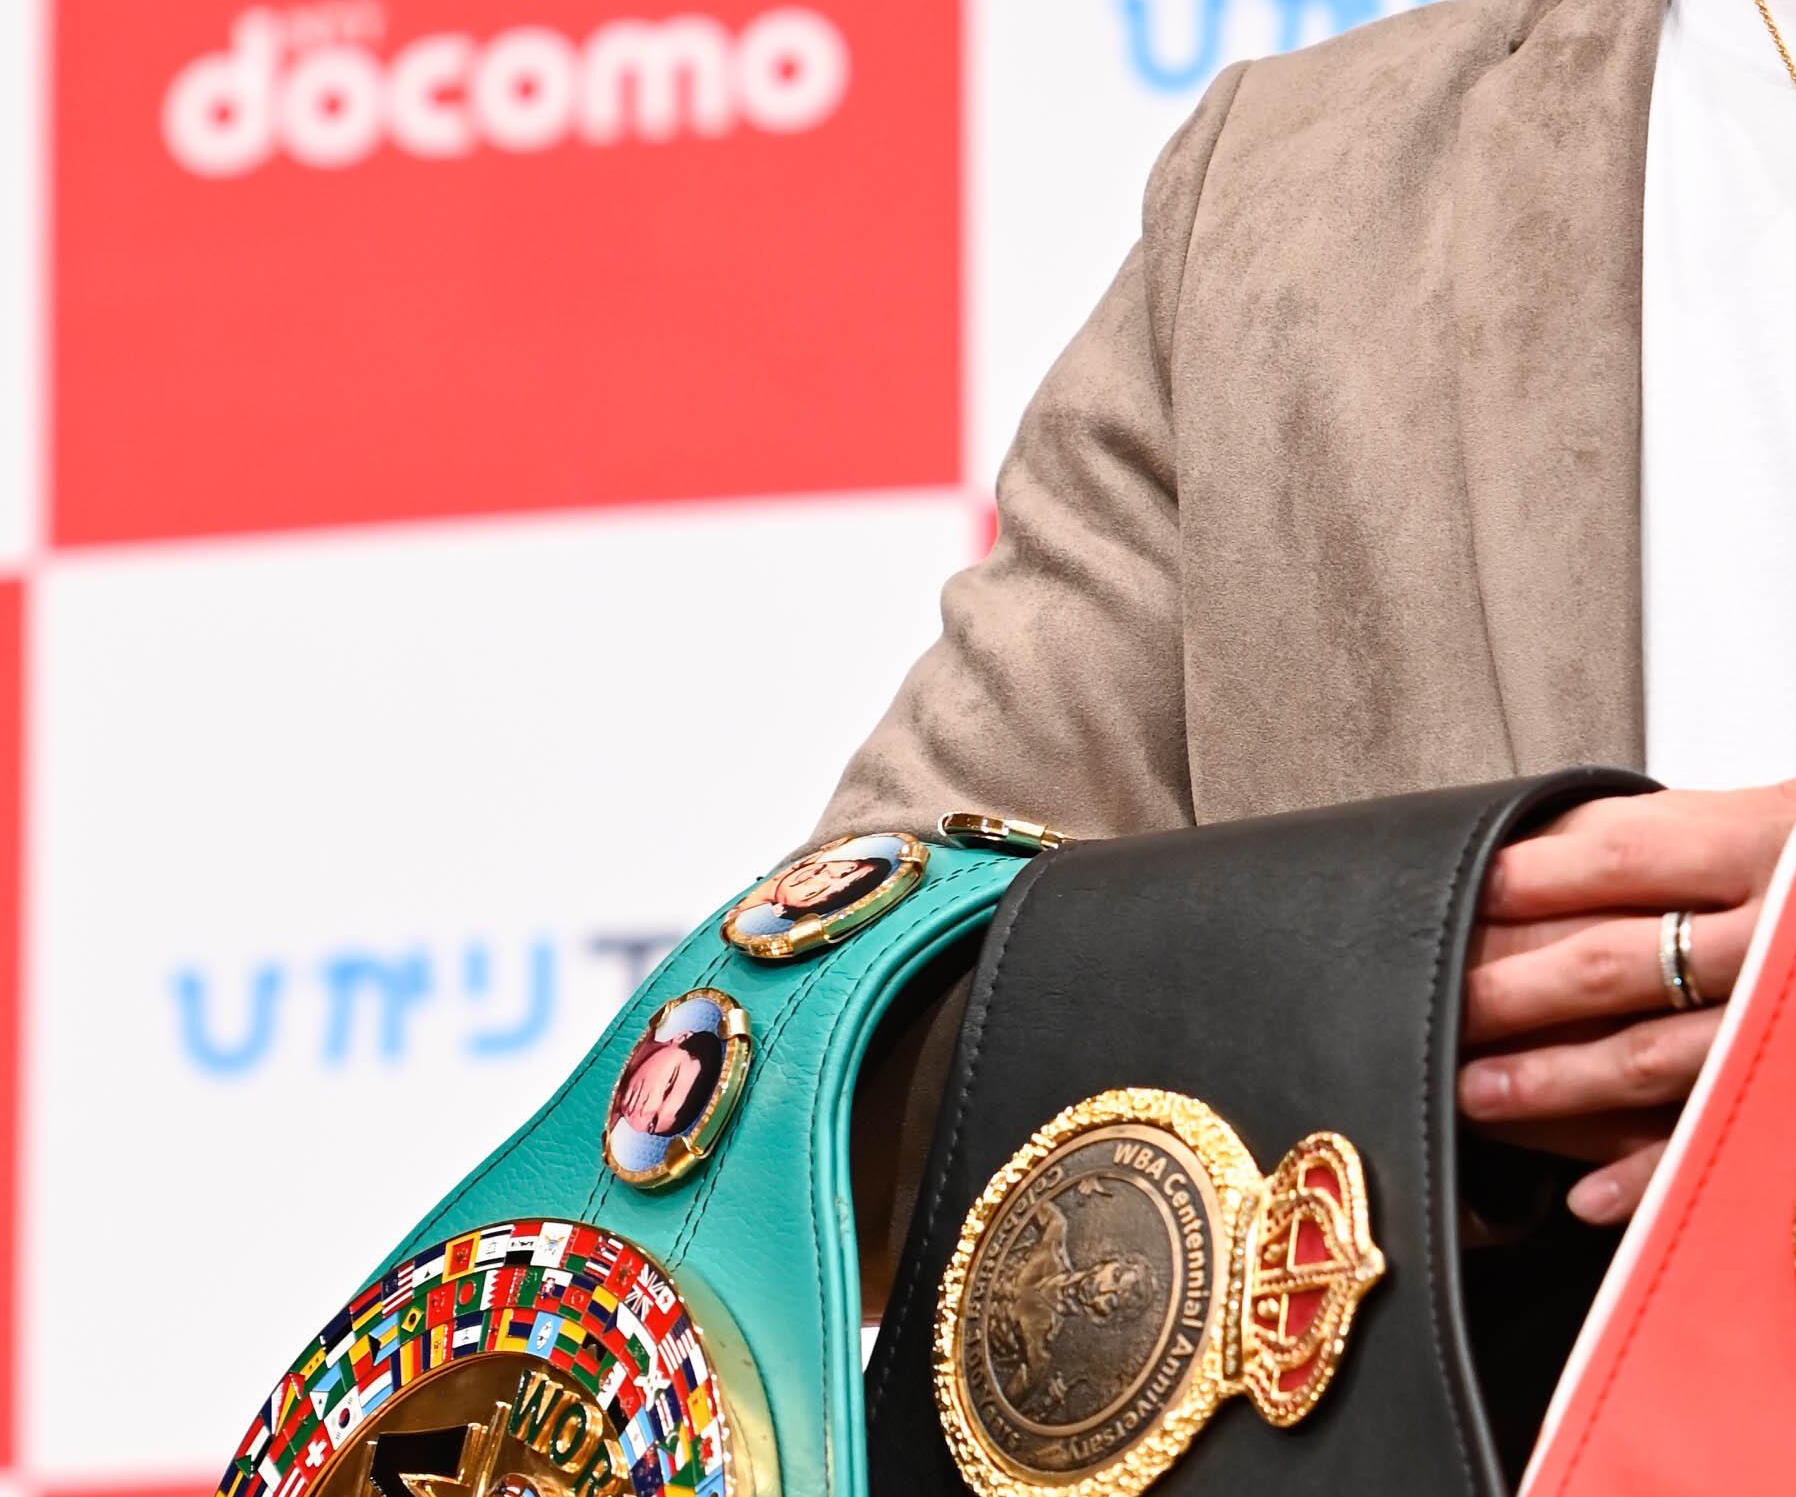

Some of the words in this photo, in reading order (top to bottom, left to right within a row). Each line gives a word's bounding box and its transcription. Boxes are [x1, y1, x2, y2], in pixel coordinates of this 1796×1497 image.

[162, 6, 851, 179] docomo
[168, 921, 692, 1081] ひかりT
[1112, 1141, 1165, 1184] WBA
[1162, 1168, 1203, 1329] Centennial
[1066, 1335, 1195, 1462] Anniversary
